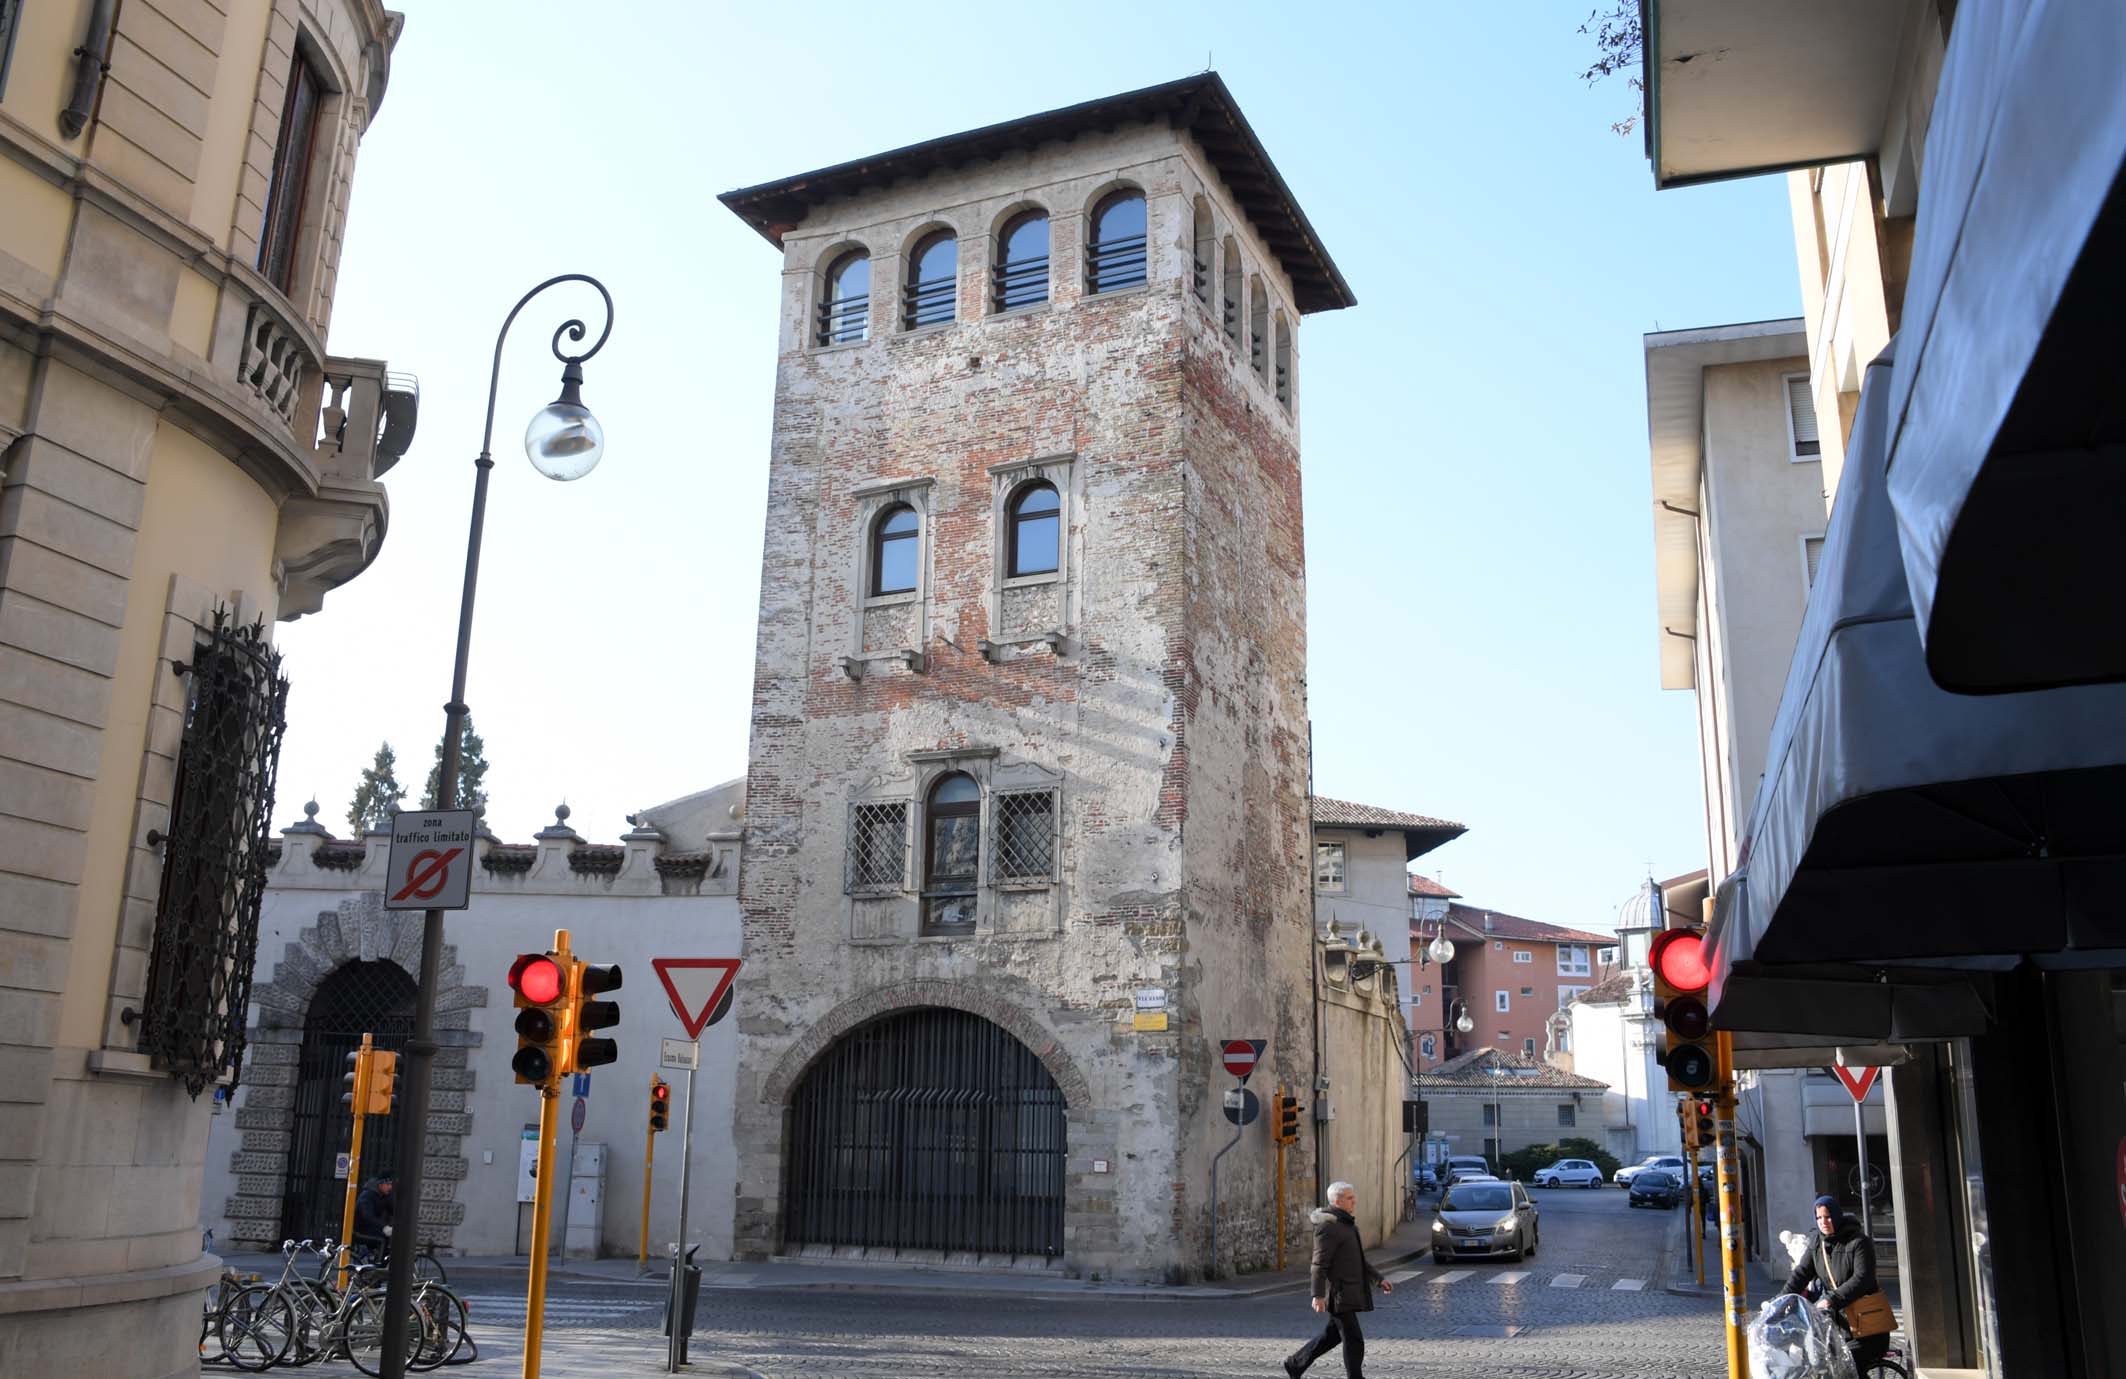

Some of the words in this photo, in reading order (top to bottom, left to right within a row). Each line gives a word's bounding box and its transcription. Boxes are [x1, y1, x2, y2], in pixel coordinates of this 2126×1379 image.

[424, 819, 442, 828] zona
[396, 832, 430, 843] traffico
[433, 832, 470, 842] limitato
